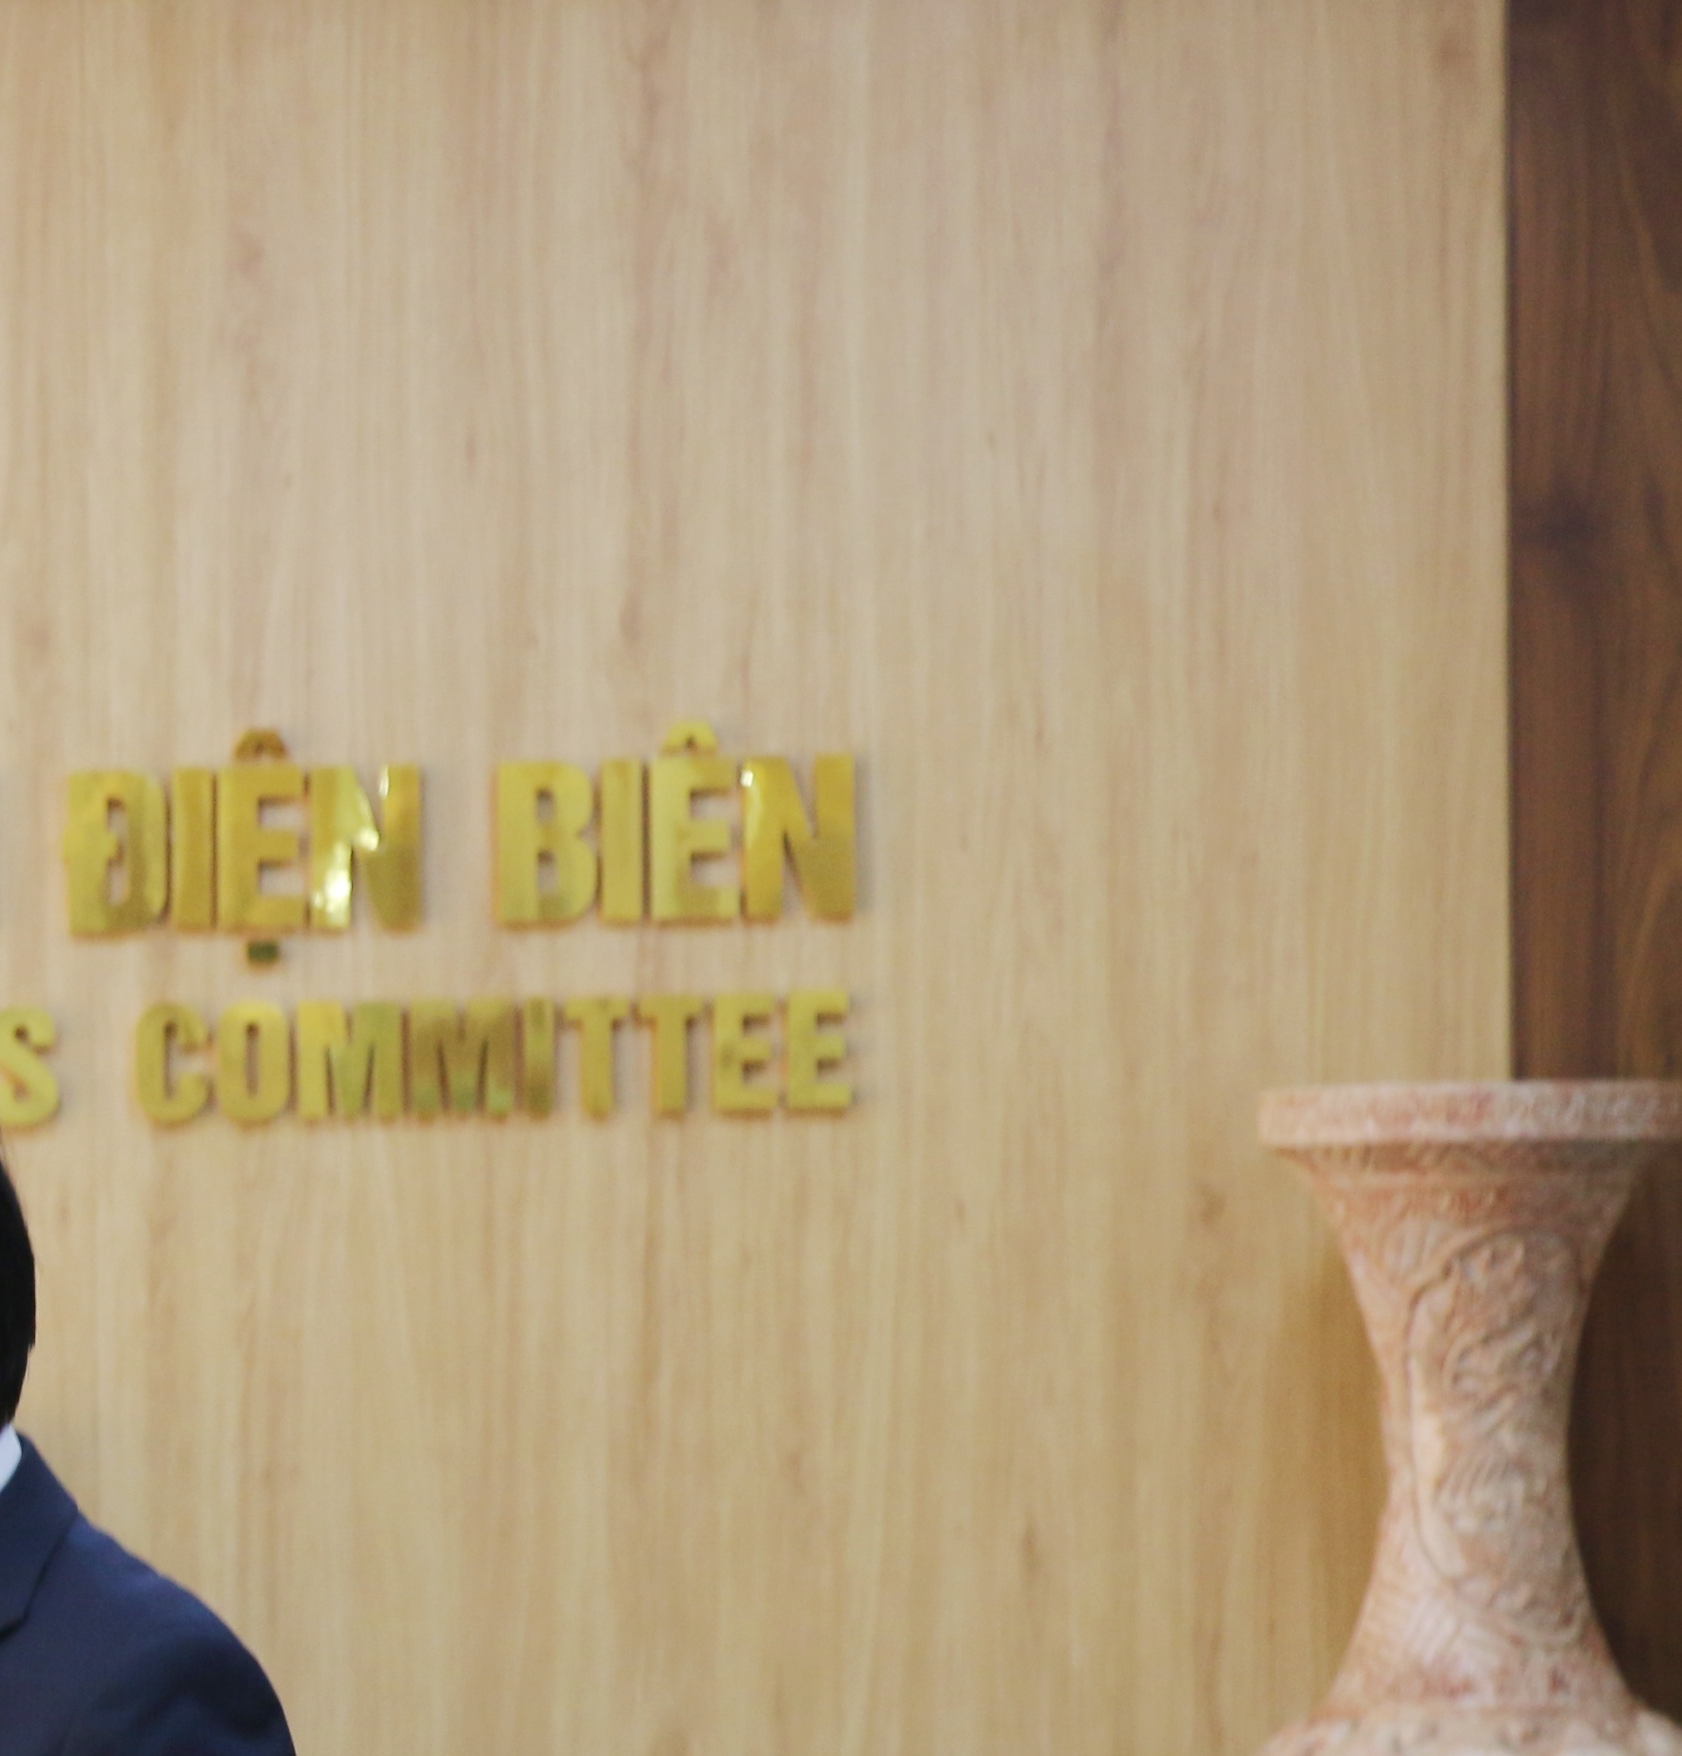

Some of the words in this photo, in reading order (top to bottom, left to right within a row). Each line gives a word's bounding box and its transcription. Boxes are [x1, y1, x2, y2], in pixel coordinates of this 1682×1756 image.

[62, 729, 423, 970] ĐIỆN
[494, 721, 856, 931] BIÊN
[135, 989, 855, 1131] COMMITTEE
